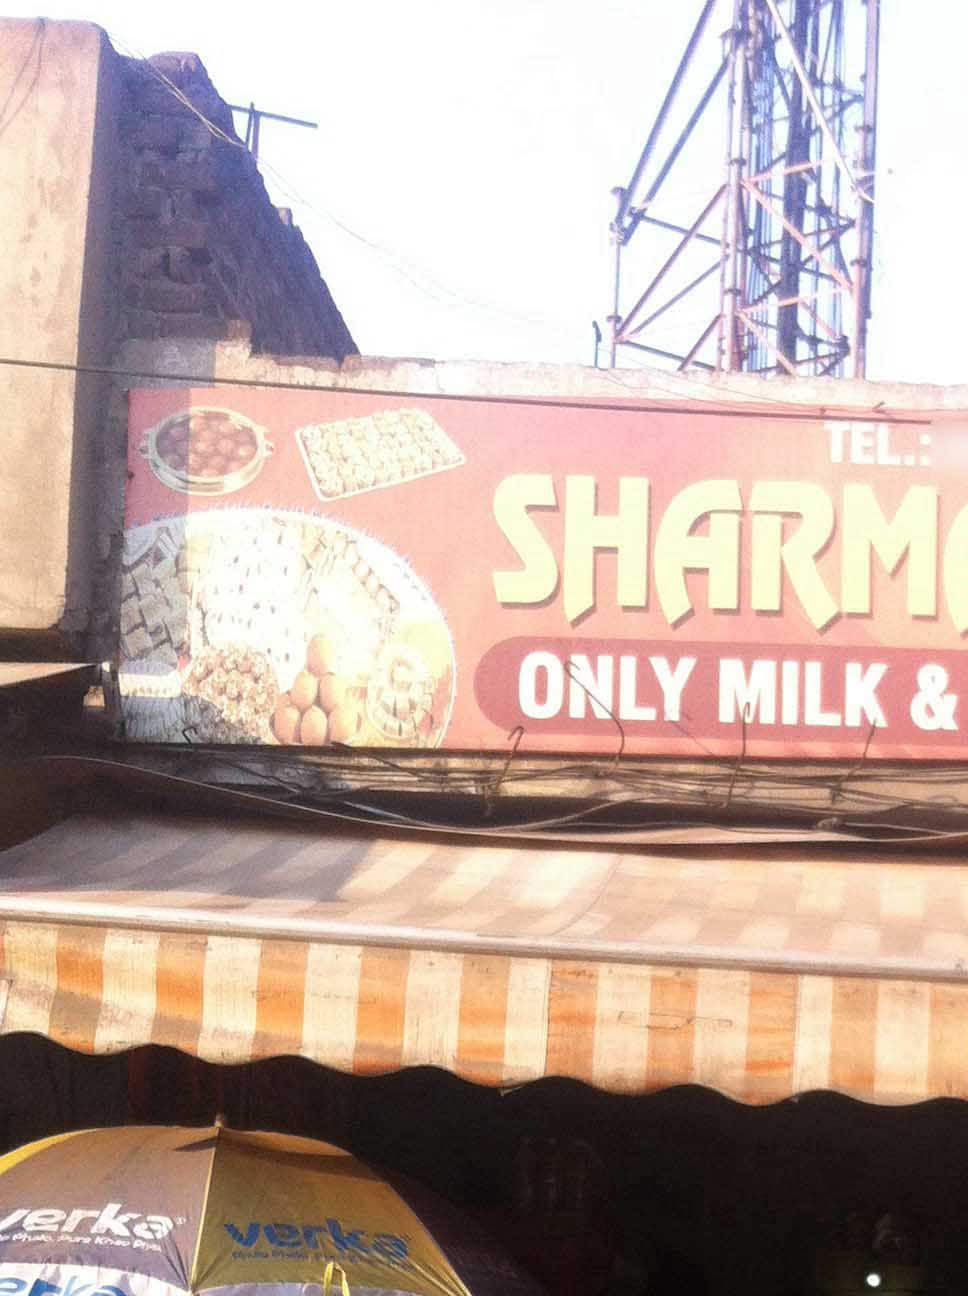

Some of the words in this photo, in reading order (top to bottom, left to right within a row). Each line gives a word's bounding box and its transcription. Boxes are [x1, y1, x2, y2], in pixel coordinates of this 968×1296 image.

[823, 421, 931, 466] TEL.:
[518, 652, 697, 722] ONLY
[717, 657, 886, 728] MILK
[909, 664, 960, 732] &
[224, 1218, 408, 1260] verka
